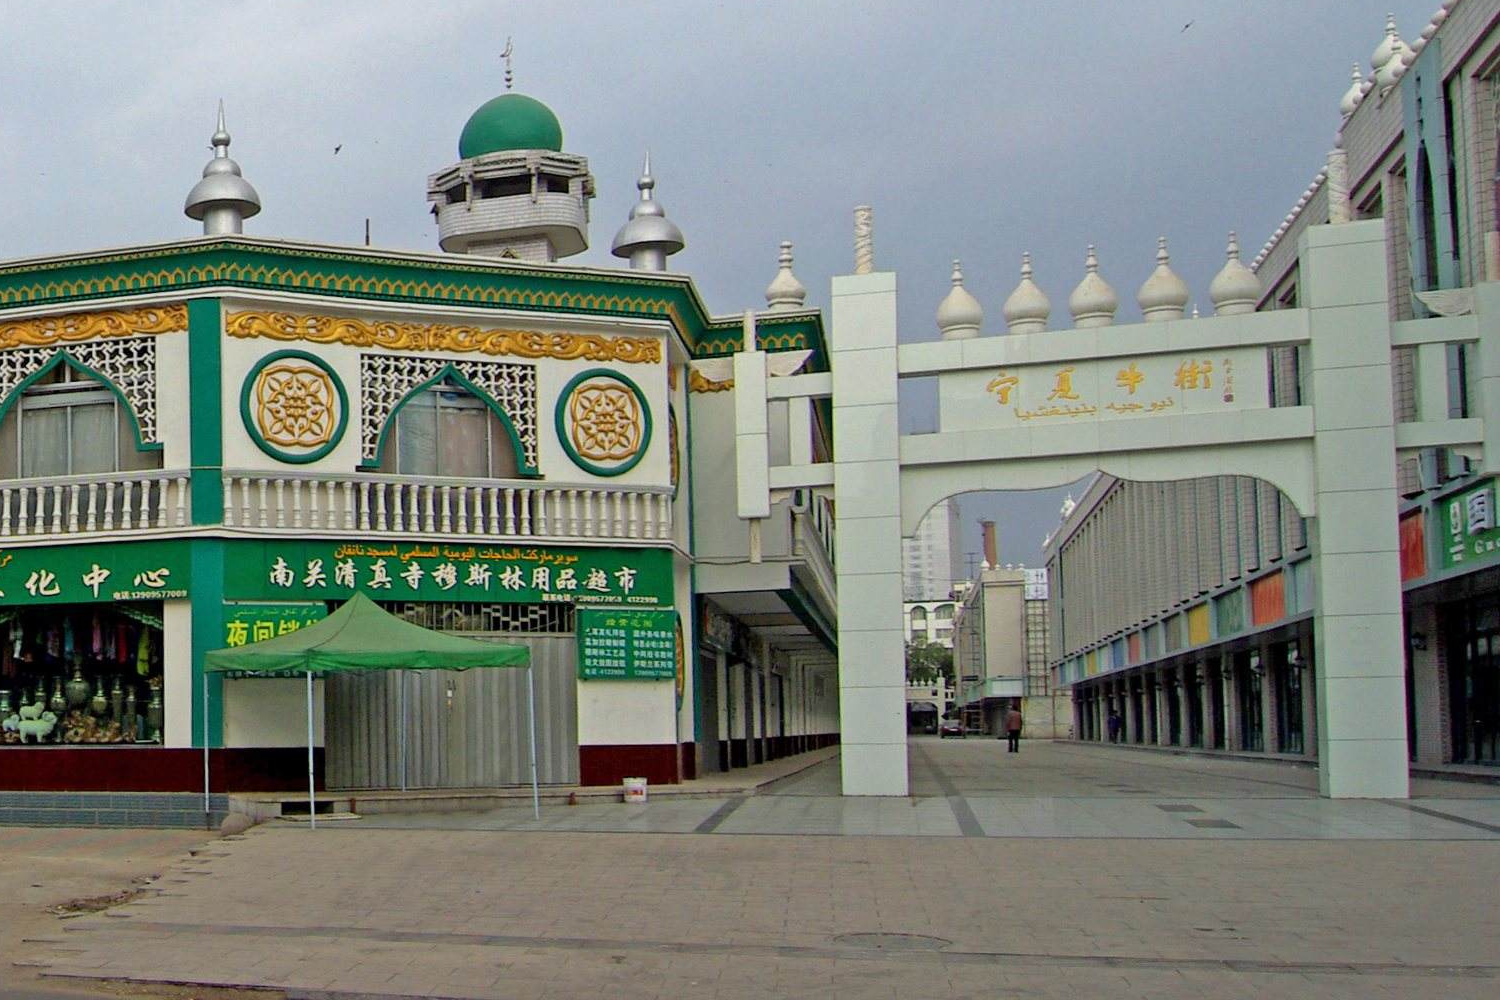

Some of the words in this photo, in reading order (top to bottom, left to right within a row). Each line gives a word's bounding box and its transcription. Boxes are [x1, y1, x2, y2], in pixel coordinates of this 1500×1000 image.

[986, 358, 1213, 405] 宁夏牛街
[269, 556, 635, 595] 南关清真寺穆斯林用品超市
